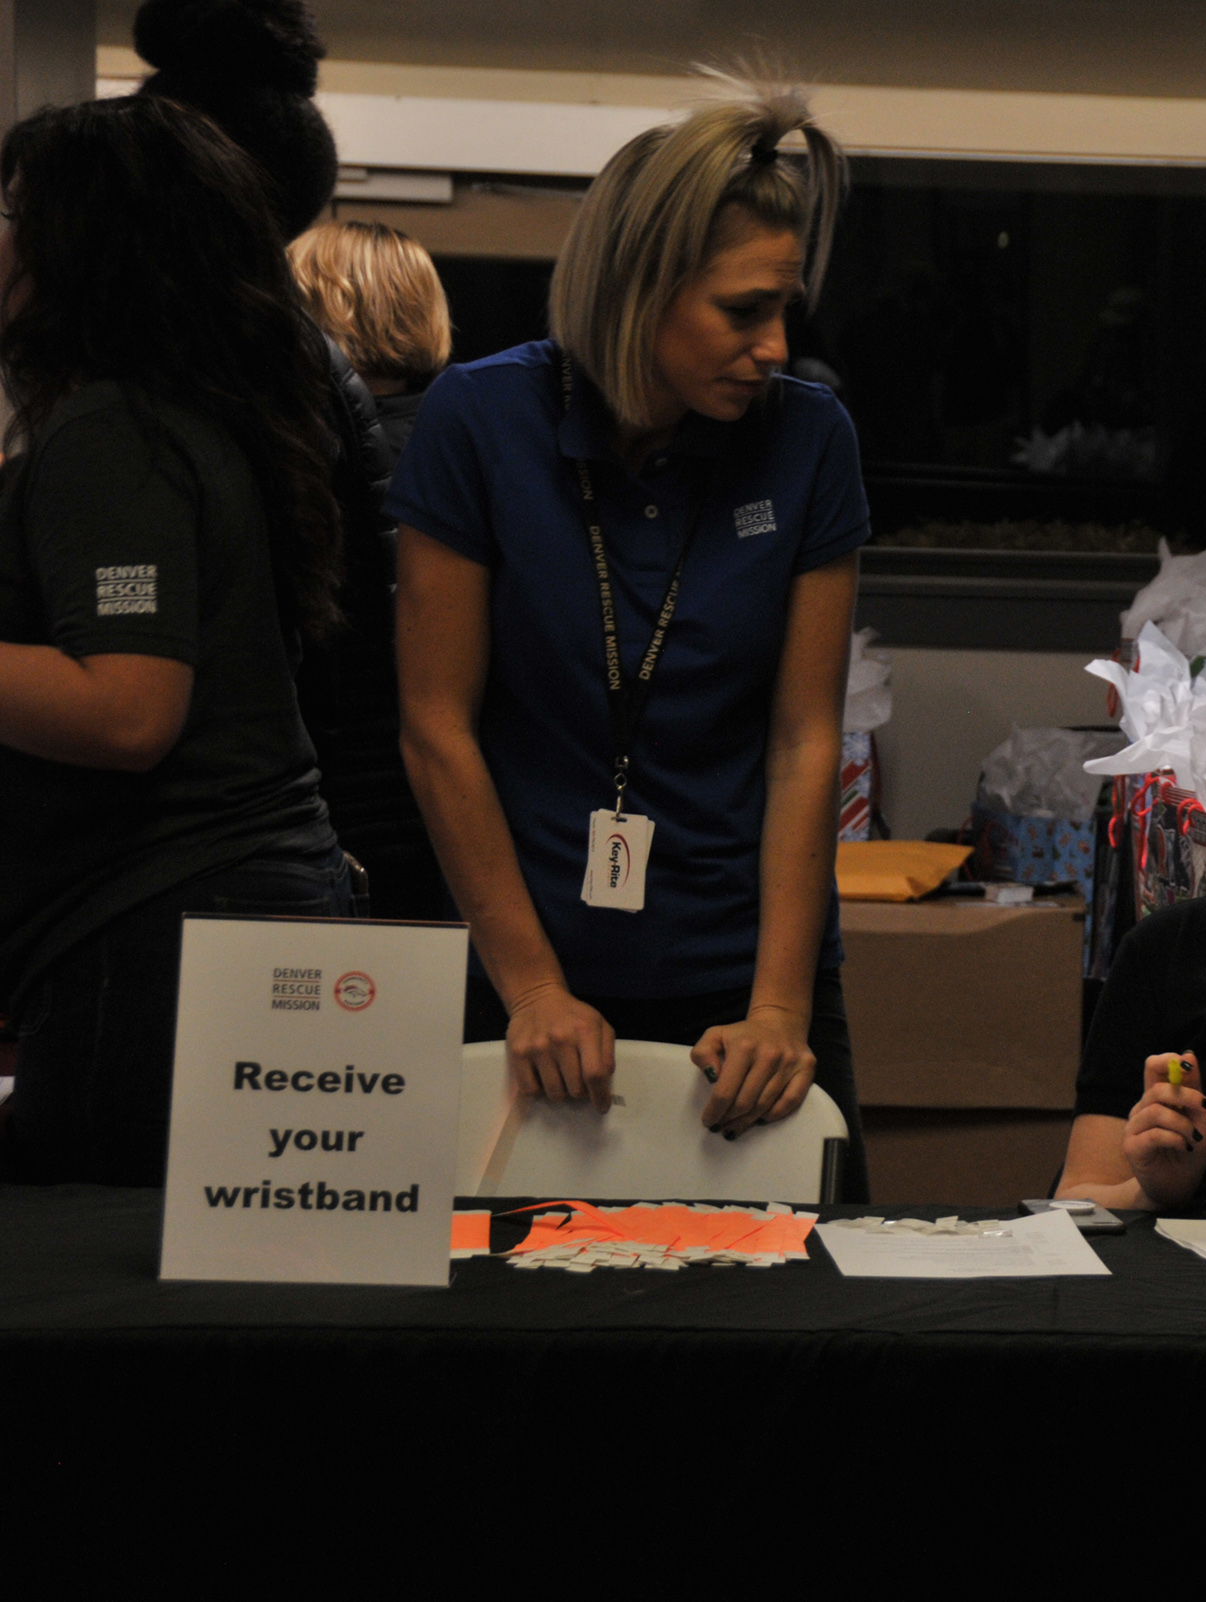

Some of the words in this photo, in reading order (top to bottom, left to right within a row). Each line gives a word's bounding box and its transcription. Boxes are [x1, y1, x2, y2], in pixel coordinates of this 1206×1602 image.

[561, 356, 573, 392] NVER
[576, 458, 594, 500] SSION
[733, 499, 772, 517] DENVER
[735, 510, 775, 527] RESCUE
[737, 522, 777, 539] MISSION
[589, 525, 608, 578] DENVER
[95, 564, 158, 580] DENVER
[96, 582, 158, 599] RESCUE
[96, 600, 158, 616] MISSION
[600, 582, 616, 632] RESCUE
[605, 635, 621, 690] MISSION
[638, 628, 665, 680] DENVER
[608, 842, 621, 888] Key-Rite
[272, 984, 321, 995] RESCUE
[273, 968, 322, 980] DENVER
[272, 1000, 320, 1011] MISSION
[233, 1060, 406, 1095] Receive
[268, 1127, 364, 1158] your
[204, 1180, 420, 1213] wristband
